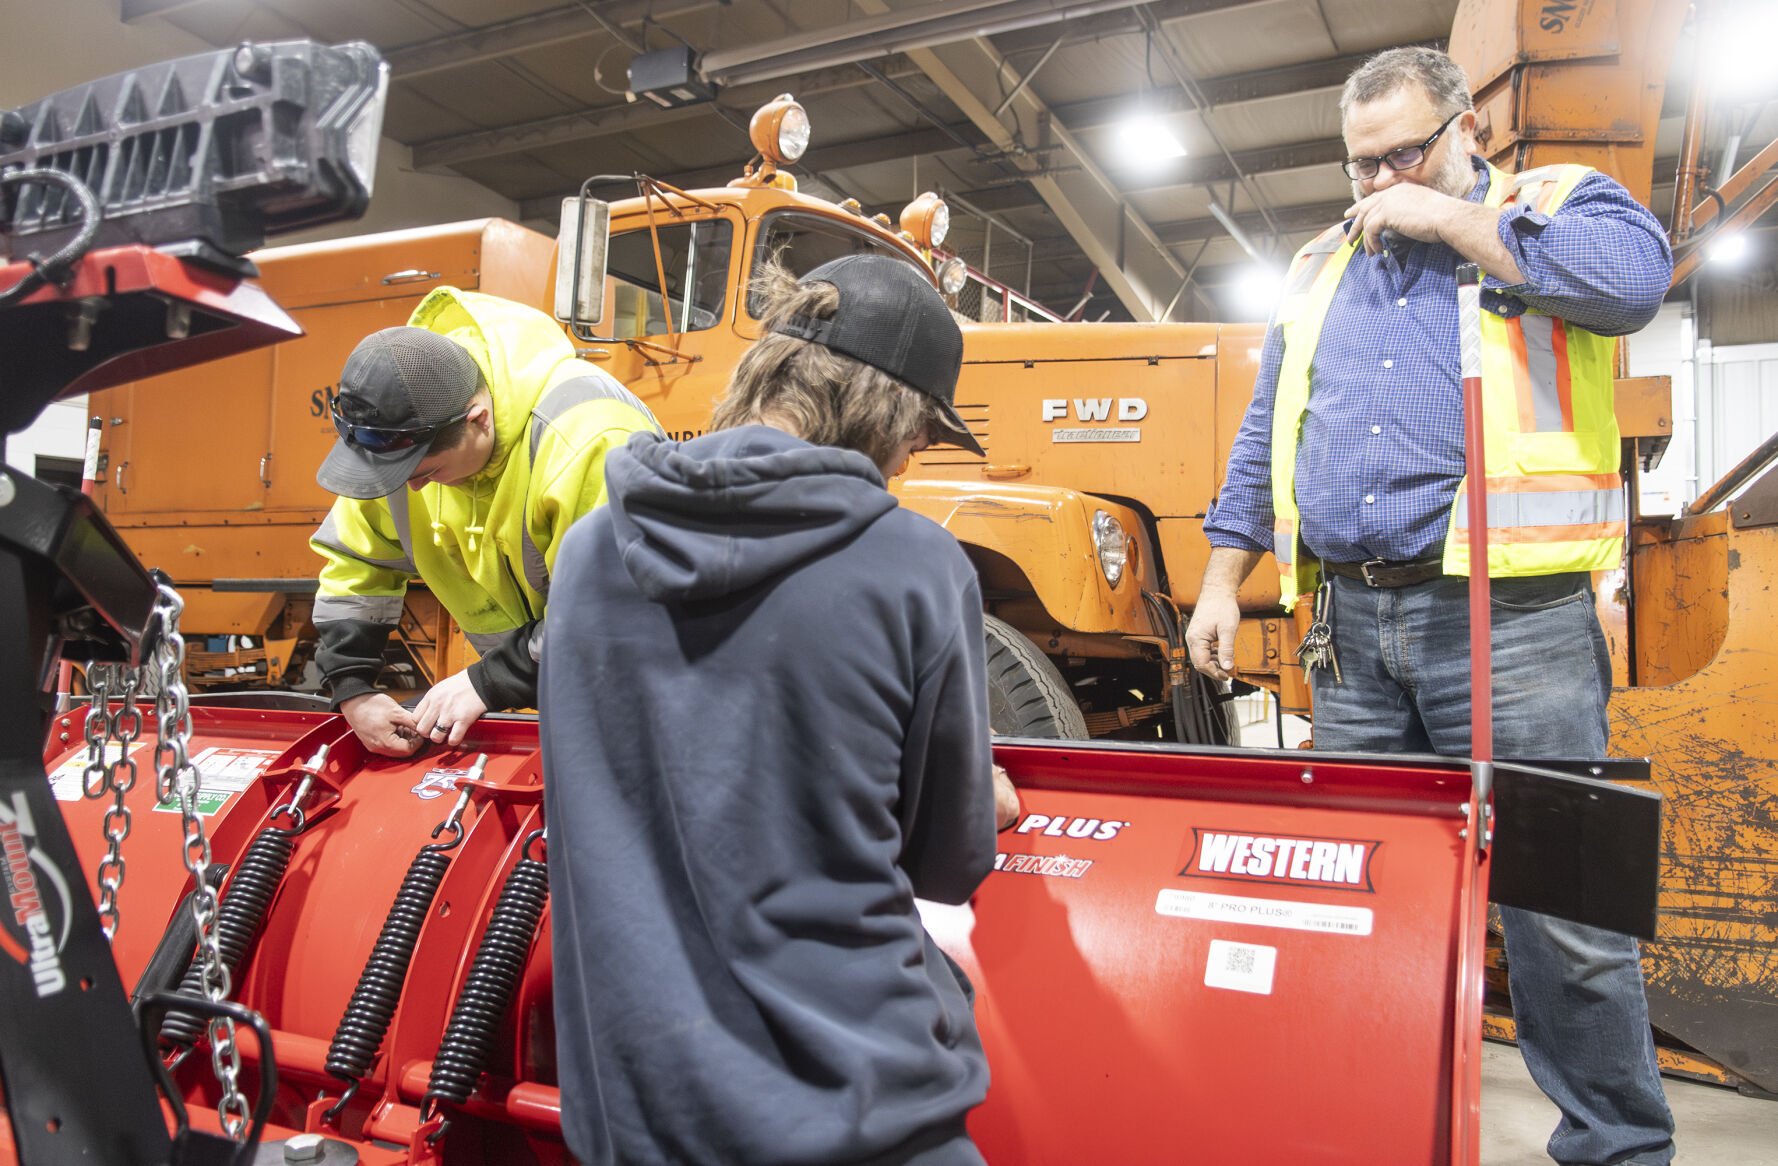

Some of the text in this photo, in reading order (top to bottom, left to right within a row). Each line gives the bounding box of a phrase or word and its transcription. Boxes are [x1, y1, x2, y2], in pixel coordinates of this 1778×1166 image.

[1042, 398, 1148, 422] FWD
[1015, 813, 1124, 841] PLUS
[1198, 833, 1365, 884] WESTERN
[1220, 901, 1246, 913] PRO
